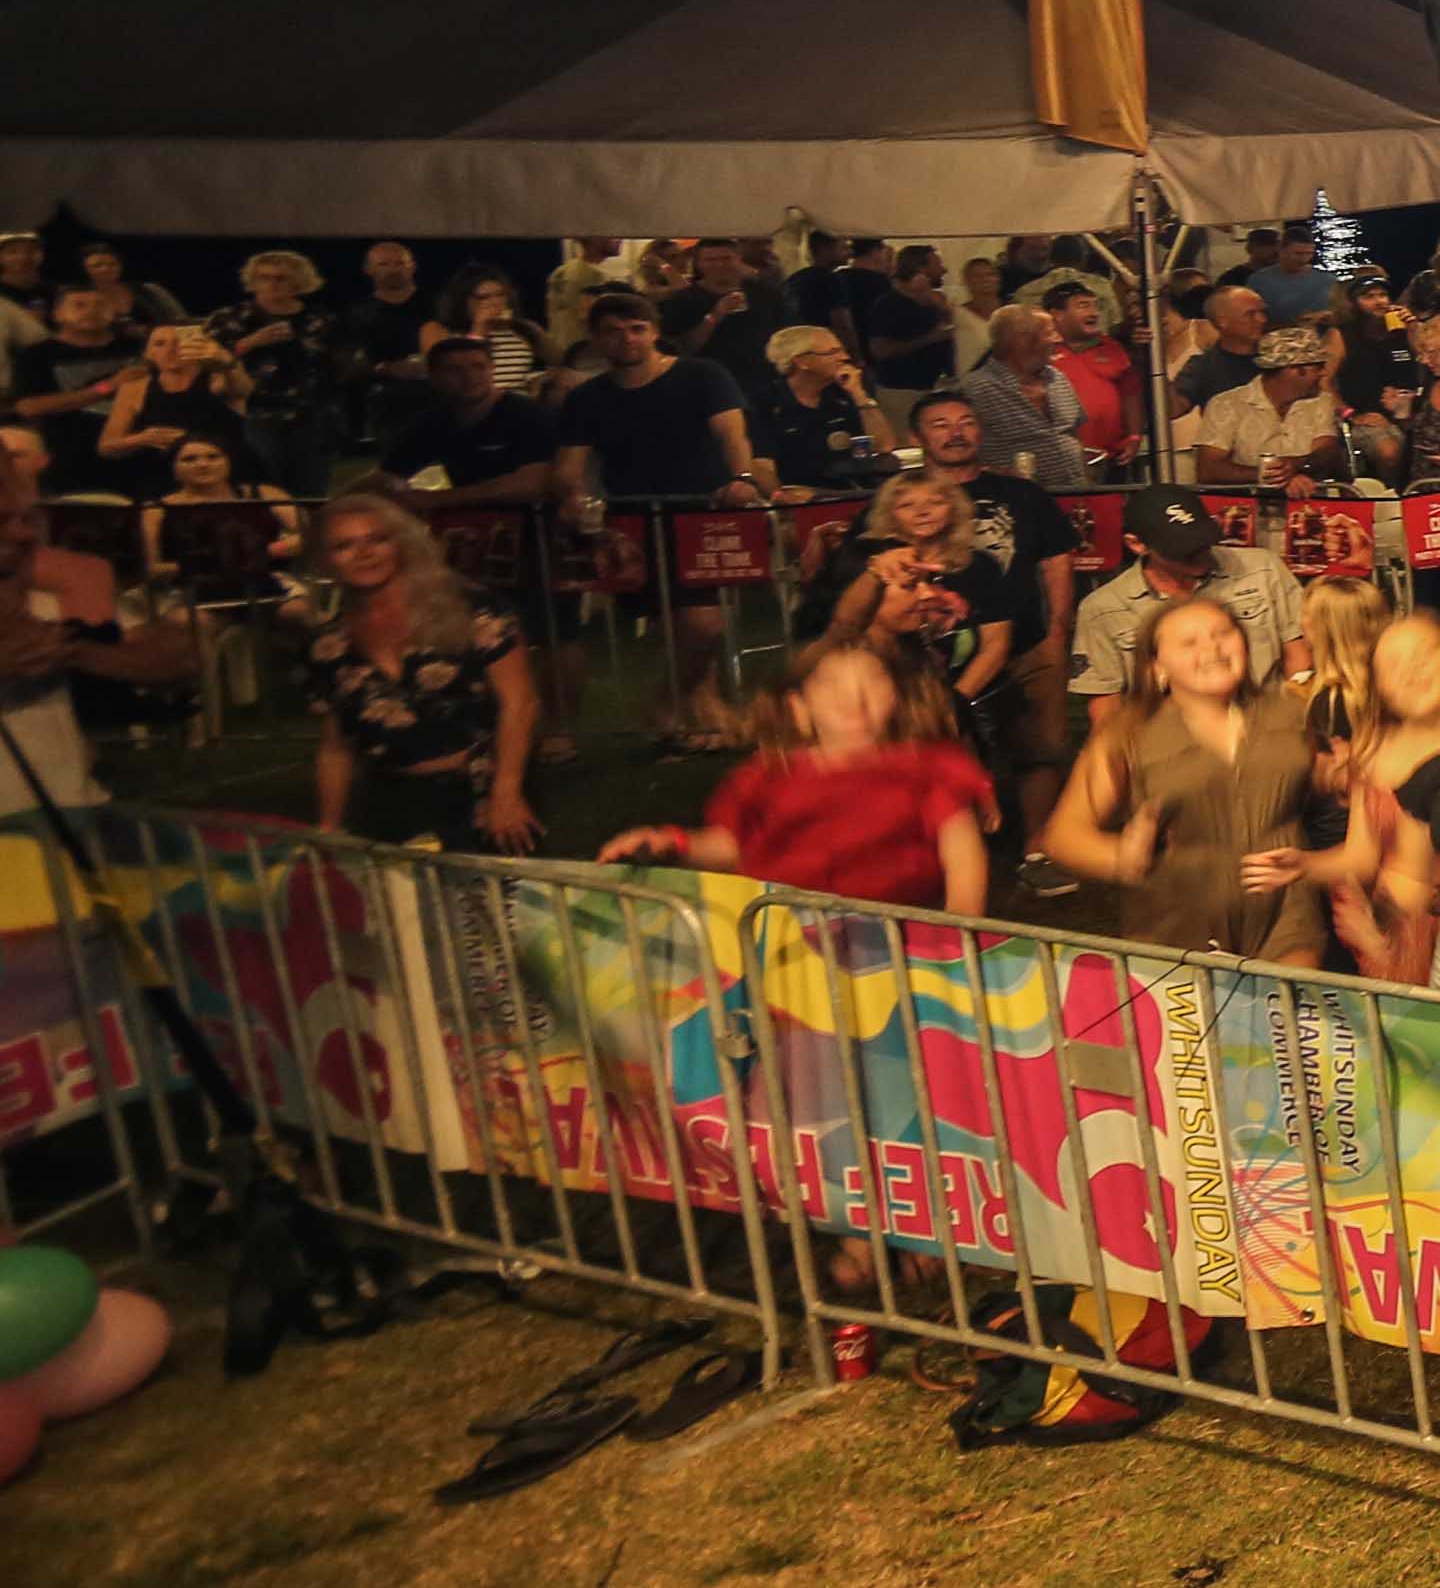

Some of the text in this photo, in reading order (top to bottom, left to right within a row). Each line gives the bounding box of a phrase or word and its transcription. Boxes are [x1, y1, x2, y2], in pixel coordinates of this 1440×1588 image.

[1266, 990, 1303, 1149] COMMERCE
[1296, 986, 1326, 1121] HAMBER
[1322, 988, 1362, 1176] WHITSUNDAY
[1165, 981, 1242, 1303] WHITSUNDAY
